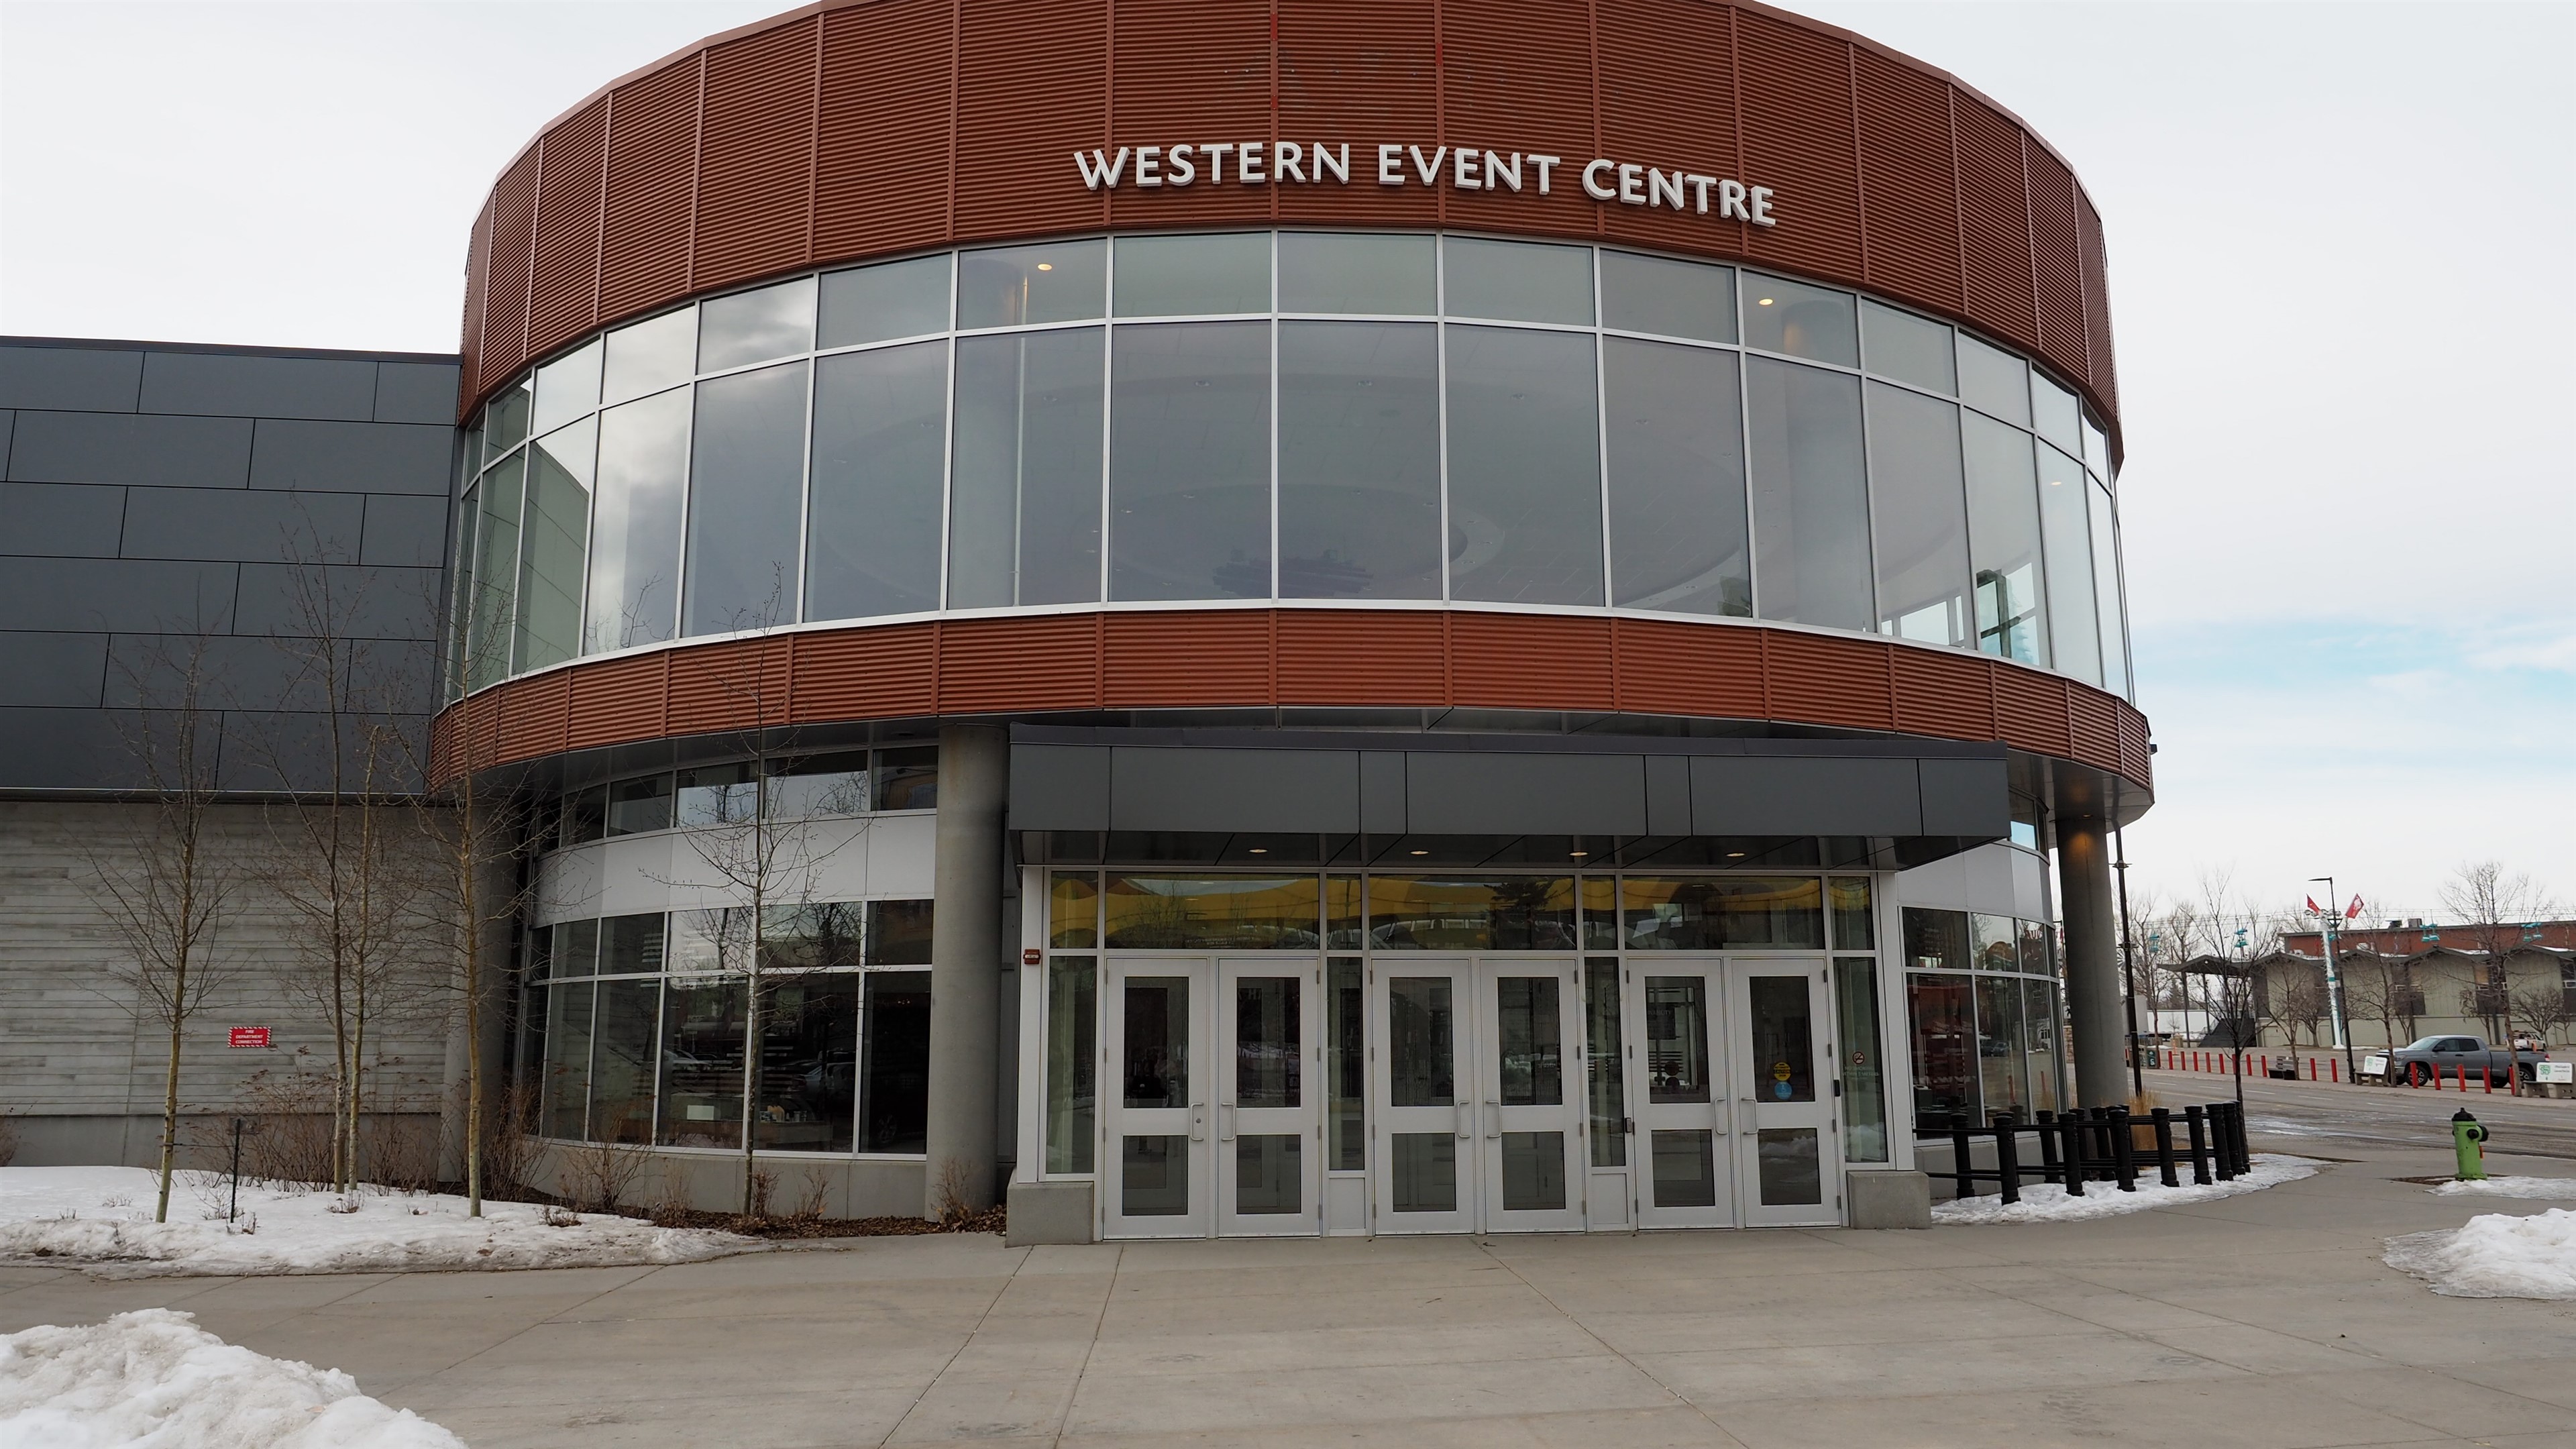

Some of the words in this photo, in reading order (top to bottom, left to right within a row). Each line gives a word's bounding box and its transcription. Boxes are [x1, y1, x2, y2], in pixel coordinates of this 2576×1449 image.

[1073, 141, 1350, 191] WESTERN
[1378, 144, 1561, 195] EVENT
[1582, 158, 1776, 228] CENTRE
